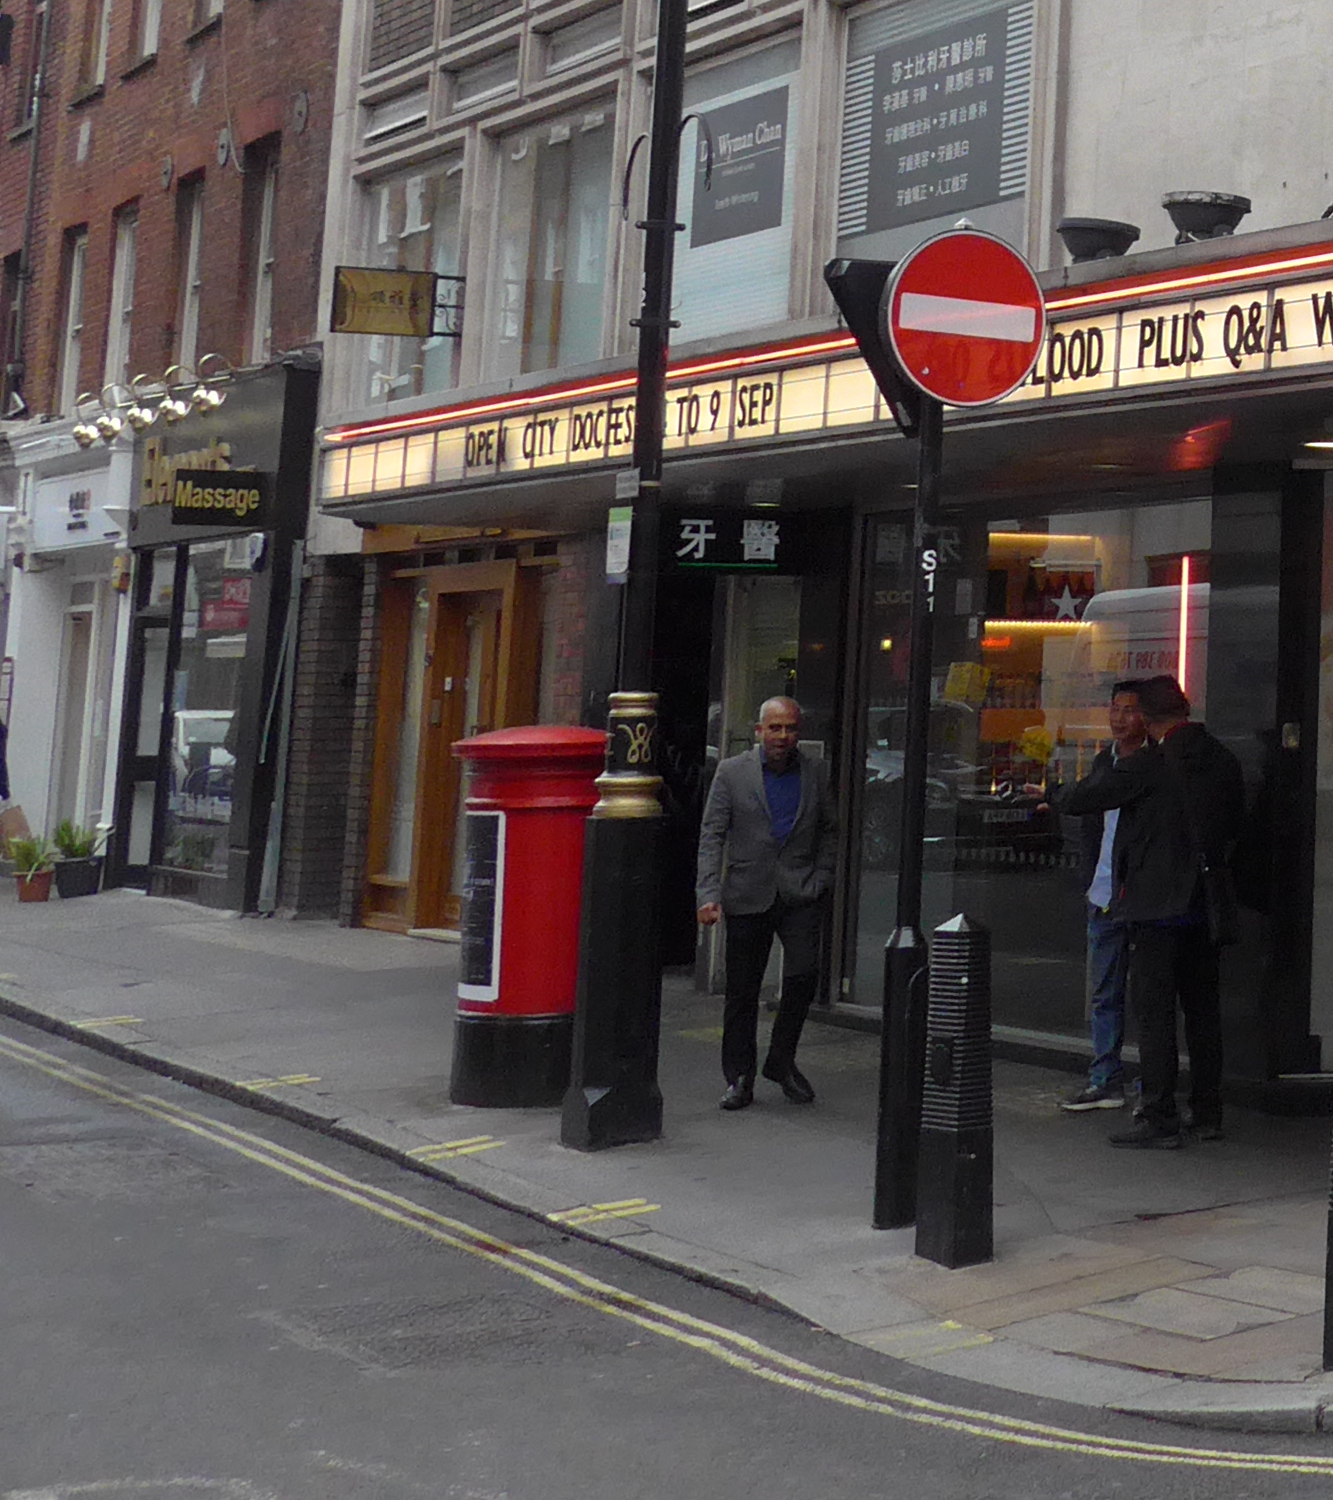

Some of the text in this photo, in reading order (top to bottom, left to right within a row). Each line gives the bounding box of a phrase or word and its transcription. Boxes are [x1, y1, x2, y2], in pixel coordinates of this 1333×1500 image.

[718, 122, 782, 162] Wyman Chan
[1138, 310, 1205, 369] PLUS
[1223, 298, 1288, 369] Q&A
[466, 382, 774, 467] OPEN CITY TO 9 SEP
[174, 480, 260, 517] Massage
[675, 519, 780, 561] 牙醫
